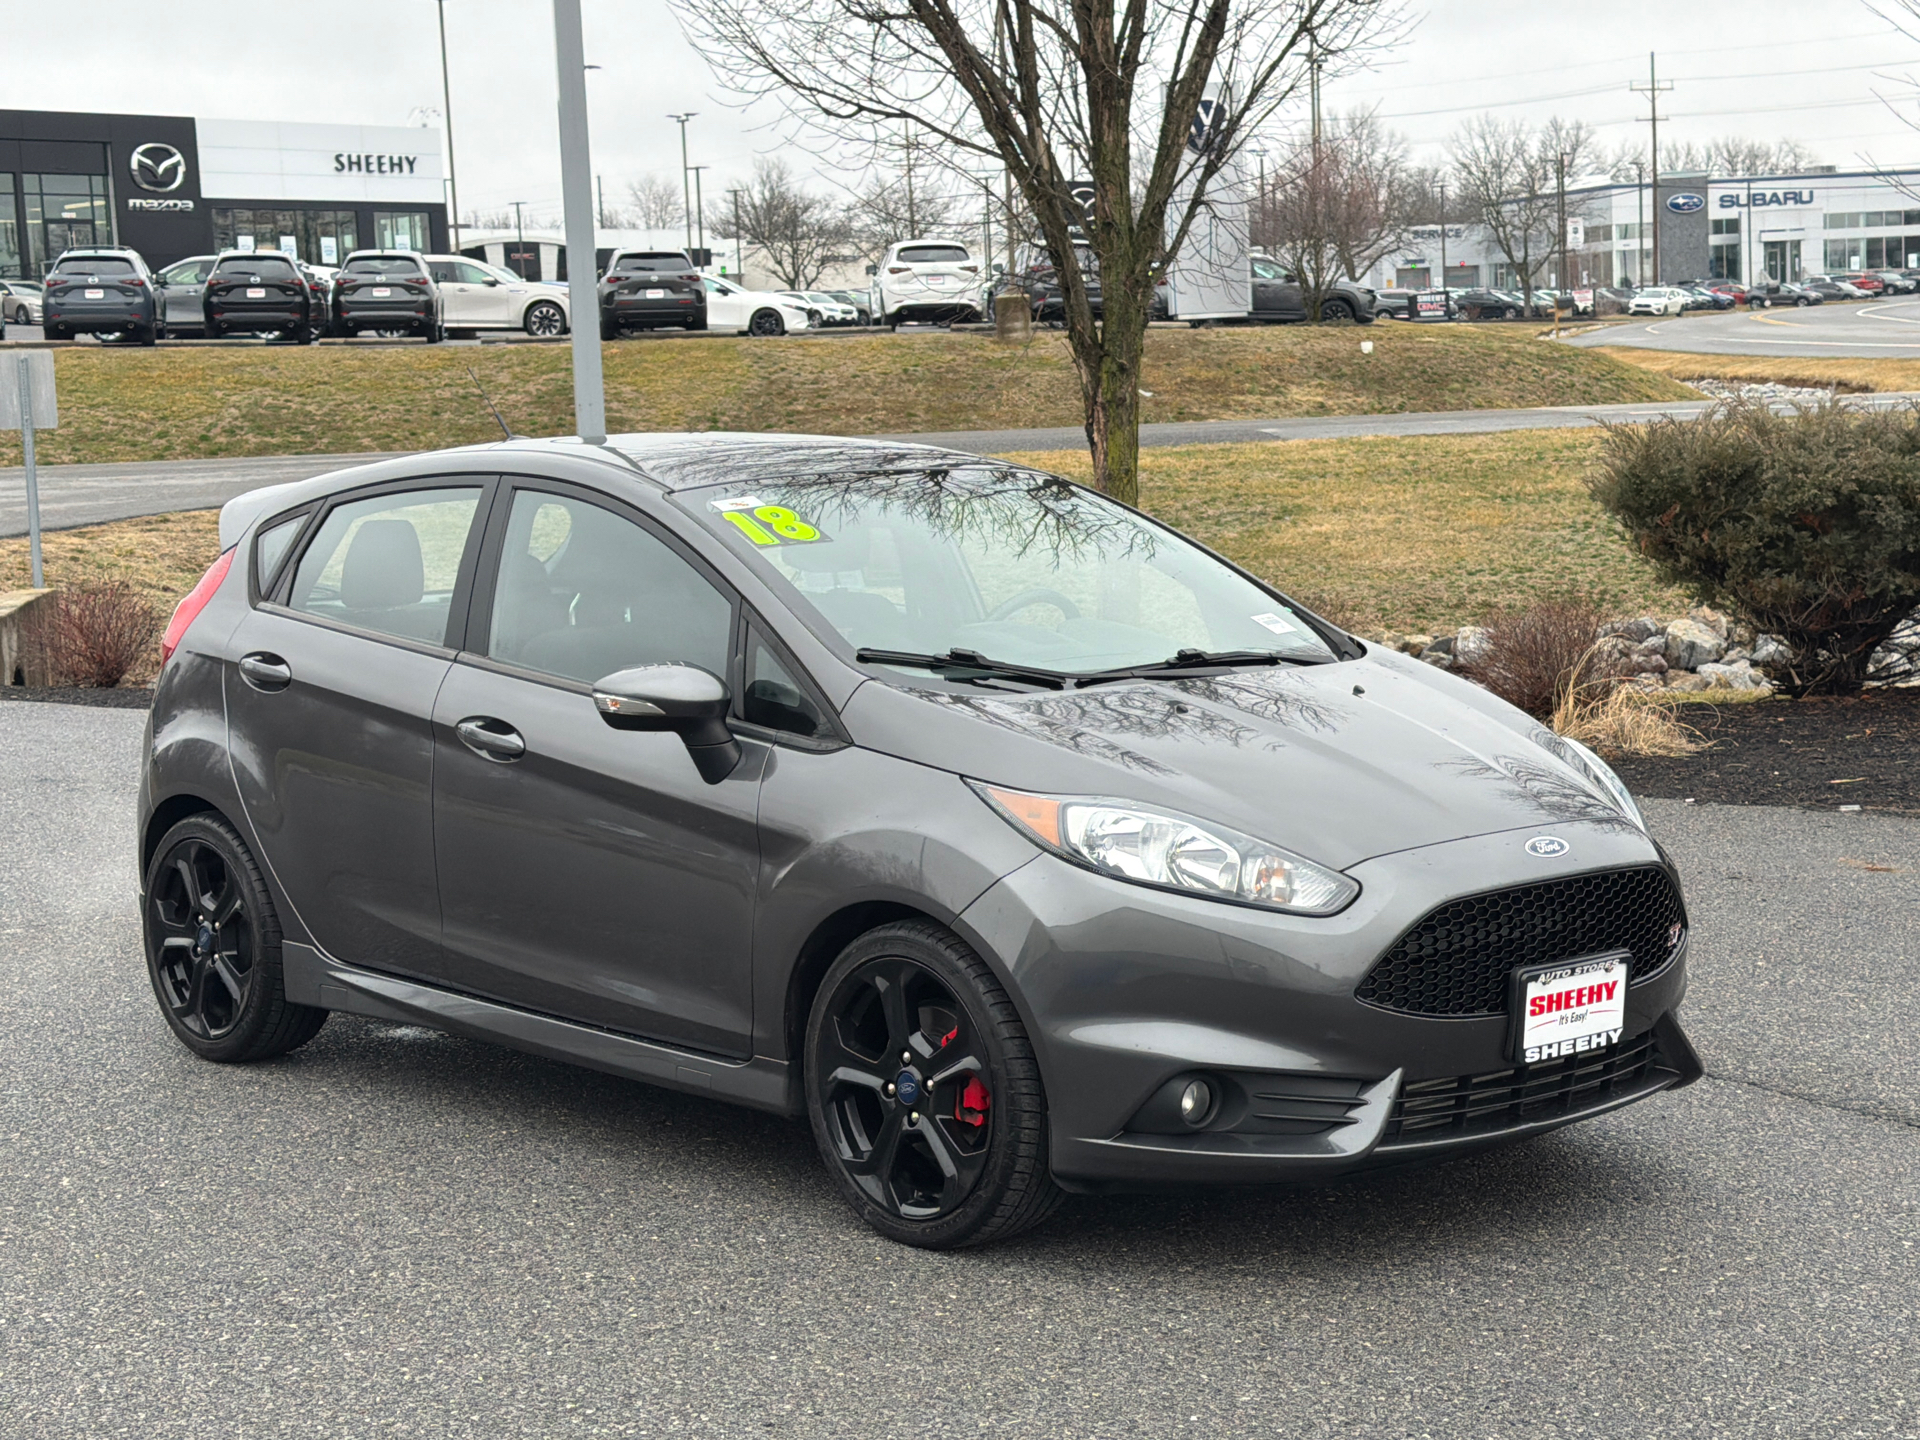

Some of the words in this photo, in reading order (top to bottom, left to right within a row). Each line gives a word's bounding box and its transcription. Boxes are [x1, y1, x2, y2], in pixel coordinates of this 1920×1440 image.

[334, 153, 417, 174] SHEEHY
[1719, 190, 1813, 208] SUBARU
[1412, 228, 1462, 239] SERVCE
[1416, 302, 1447, 311] GMC
[721, 505, 821, 546] 18
[1535, 839, 1561, 853] Ford
[1537, 968, 1572, 985] AUTO
[1573, 958, 1620, 977] STORES
[1529, 980, 1619, 1017] SHEEHY
[1559, 1014, 1569, 1026] It's
[1570, 1008, 1589, 1024] Easy!
[1524, 1028, 1623, 1063] SHEEHY
